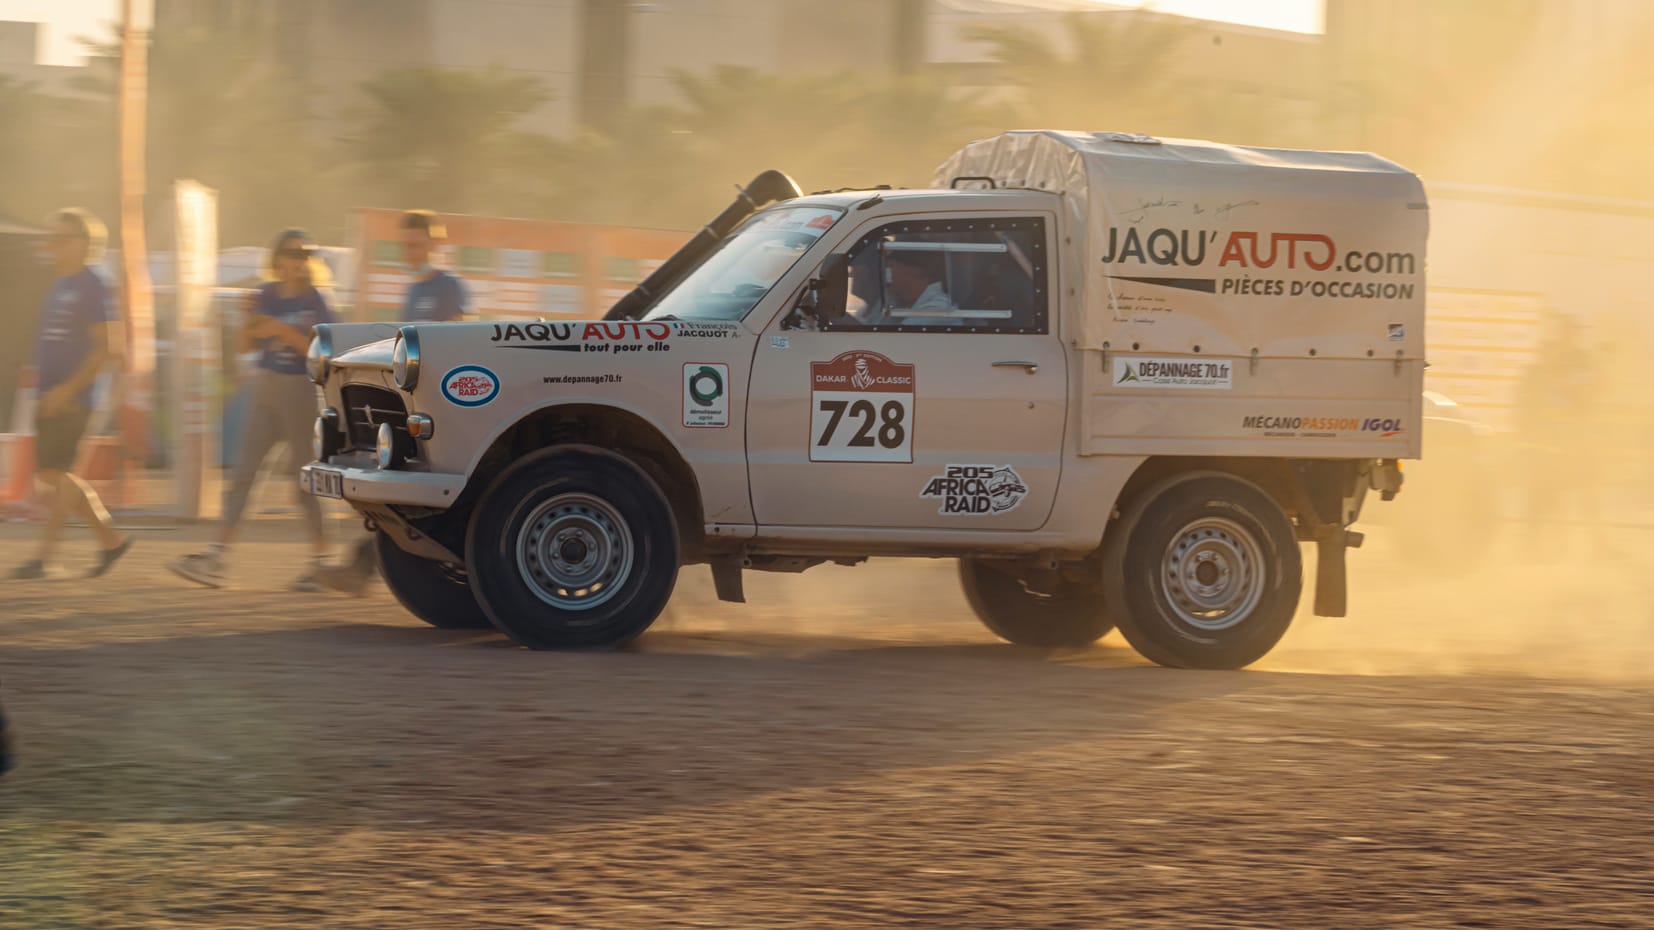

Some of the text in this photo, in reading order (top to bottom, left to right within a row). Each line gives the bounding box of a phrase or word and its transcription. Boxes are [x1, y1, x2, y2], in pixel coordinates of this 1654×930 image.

[1222, 274, 1414, 300] PIÈCES D'OCCASION
[677, 330, 728, 338] JACQUOT
[584, 342, 671, 354] tout pour elle
[1139, 361, 1203, 378] DÉPANNAGE
[543, 374, 622, 385] www.depannage70.fr
[816, 375, 911, 384] DAKAR CLASSIC
[817, 399, 905, 449] 728
[1361, 418, 1402, 432] IGOL
[947, 466, 994, 478] 205
[922, 478, 990, 496] AFRICA
[944, 496, 991, 513] RAID
